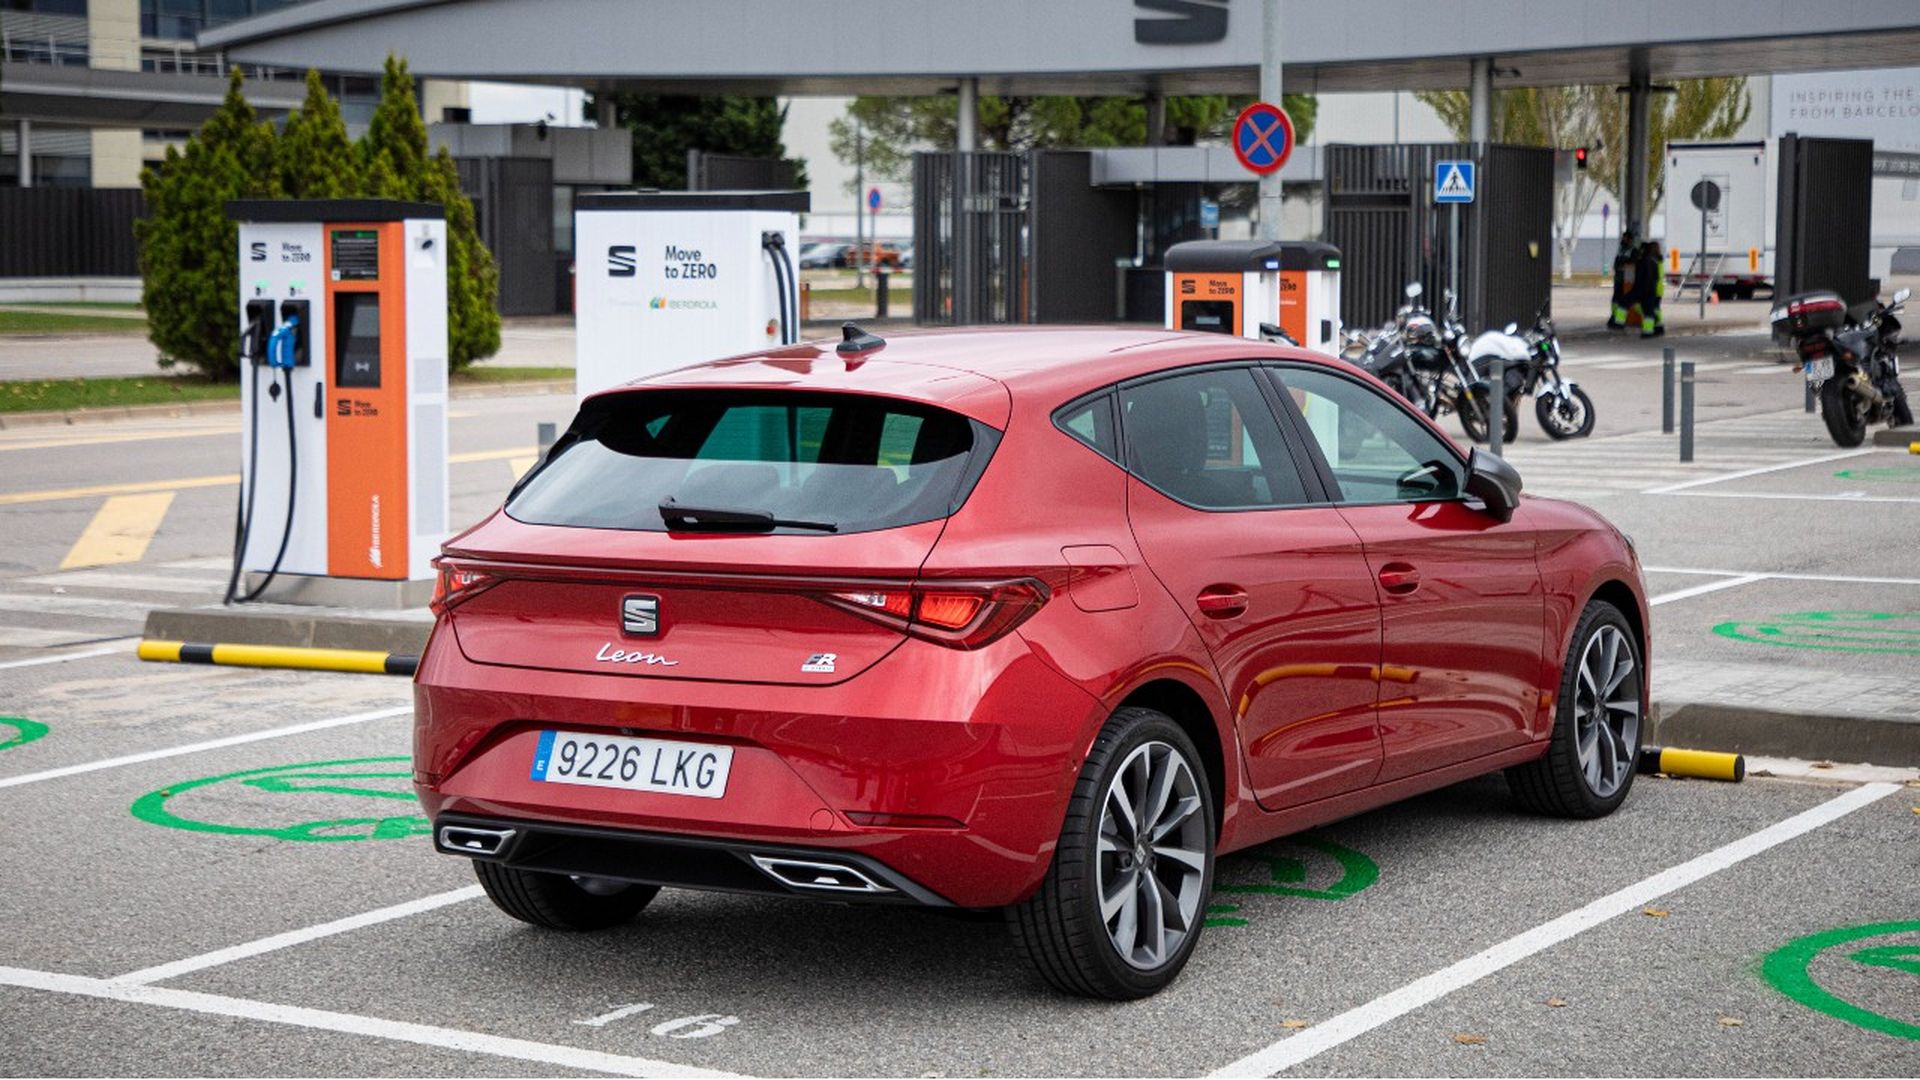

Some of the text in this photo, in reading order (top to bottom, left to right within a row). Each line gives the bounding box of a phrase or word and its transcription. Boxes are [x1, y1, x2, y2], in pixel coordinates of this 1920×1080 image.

[1790, 85, 1914, 103] INSPIRING THE
[1790, 107, 1836, 119] FROM
[665, 245, 701, 262] Move
[665, 264, 679, 279] to
[596, 642, 680, 666] Leon
[536, 740, 717, 790] E 9226 LKG
[573, 1002, 741, 1039] 16
